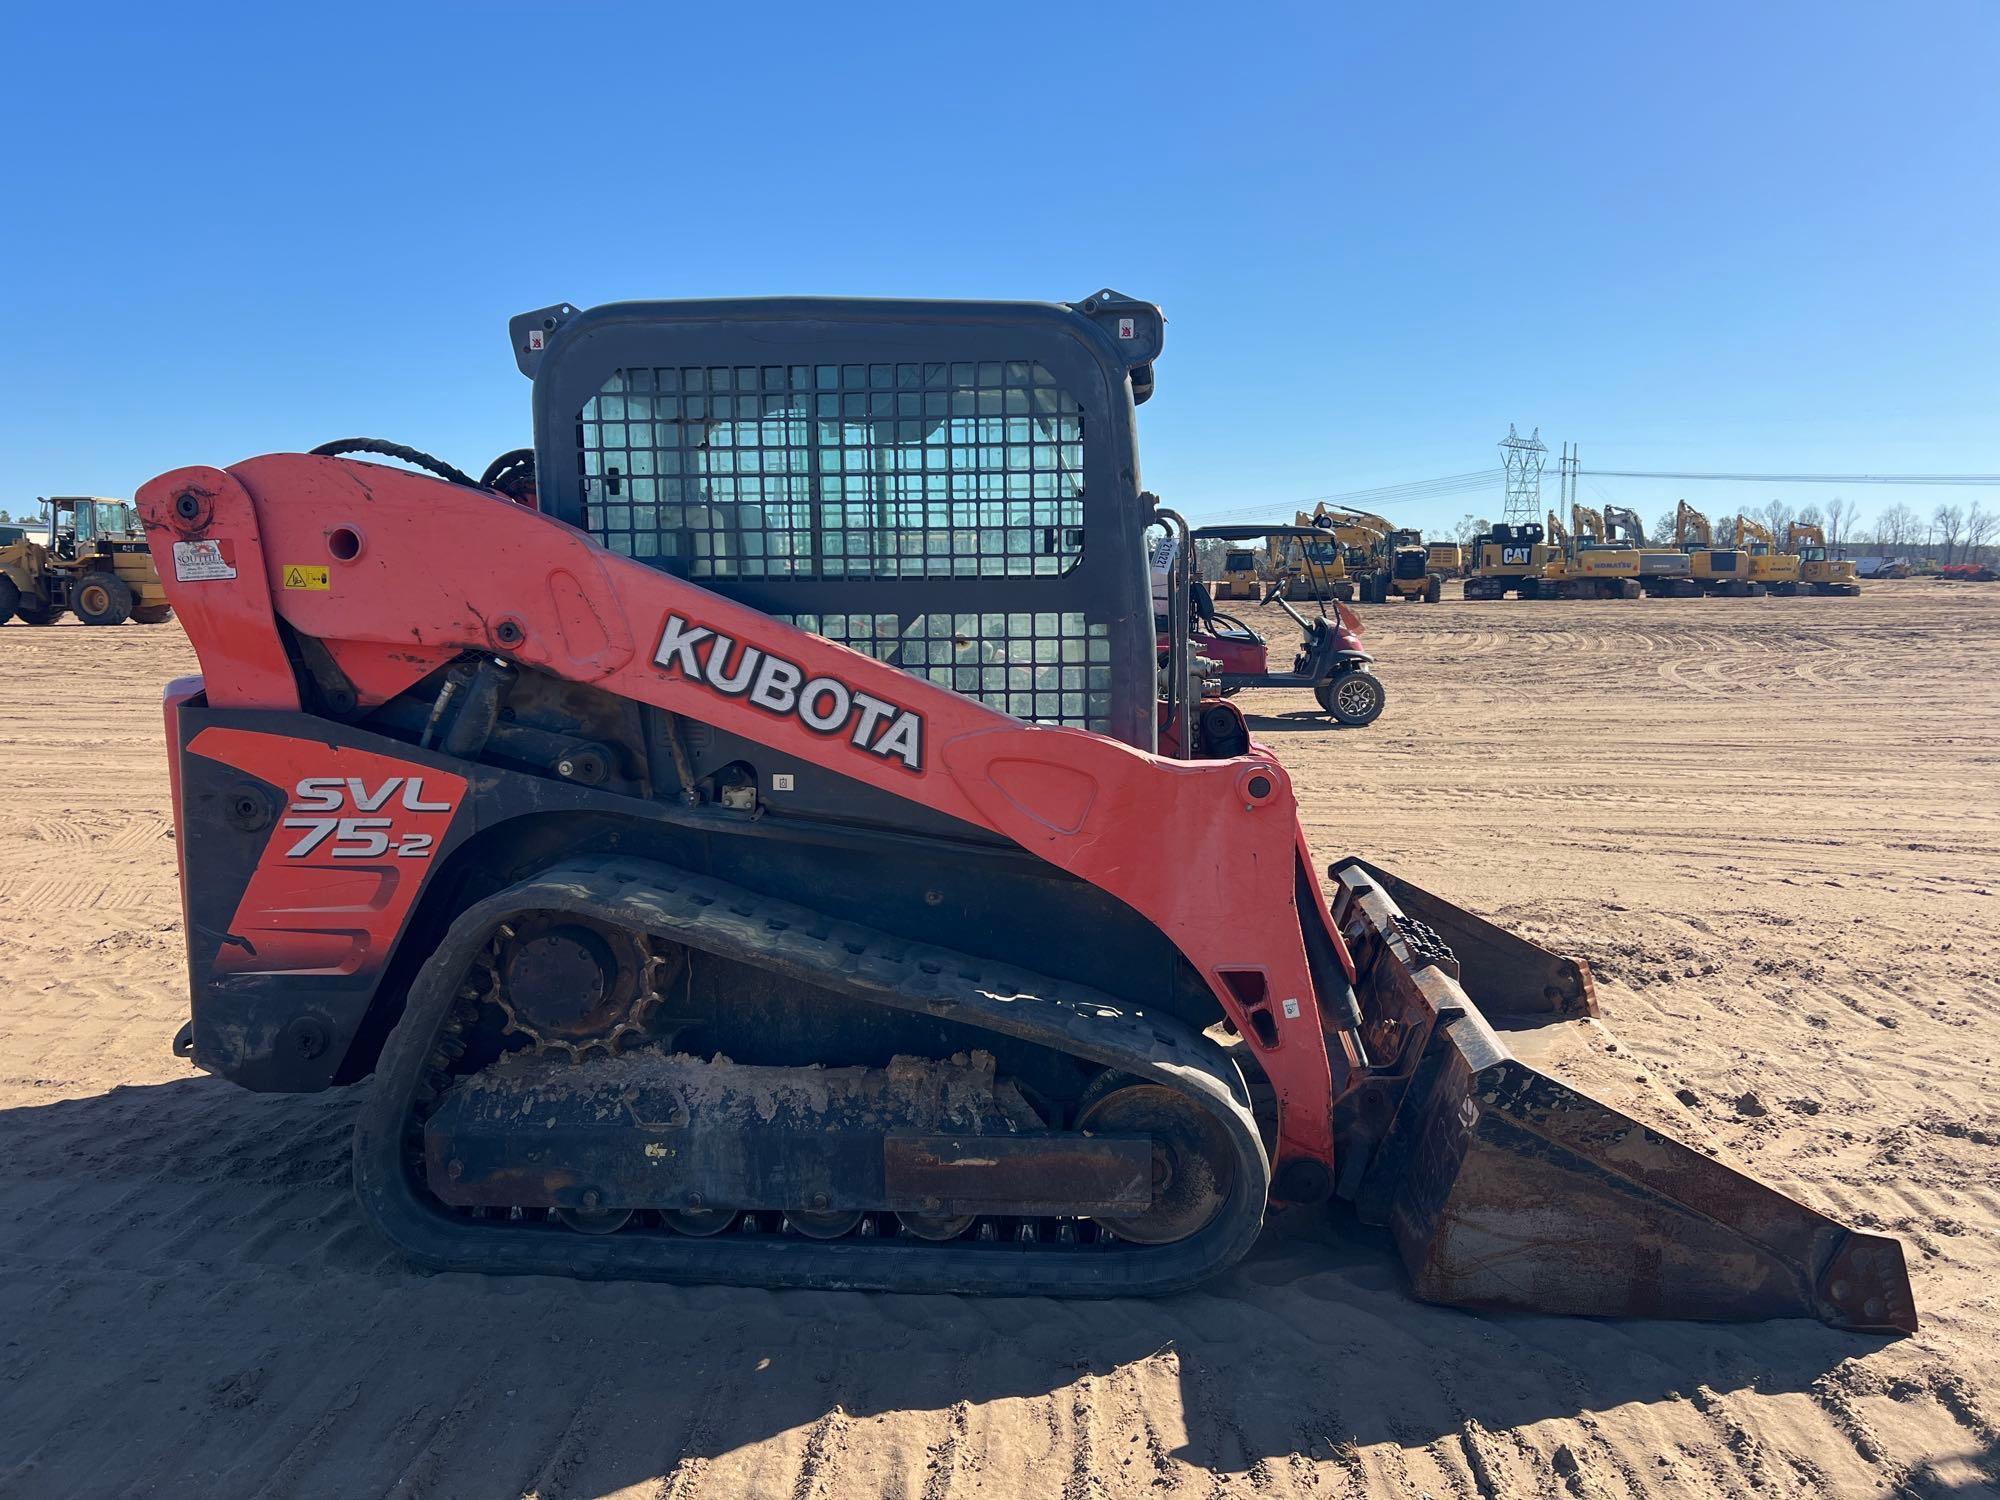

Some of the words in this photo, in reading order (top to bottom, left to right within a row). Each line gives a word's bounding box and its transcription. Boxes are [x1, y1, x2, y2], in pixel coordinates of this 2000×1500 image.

[1504, 547, 1530, 564] CAT
[653, 614, 921, 768] KUBOTA
[290, 777, 452, 812] SVL
[283, 818, 433, 858] 75-2
